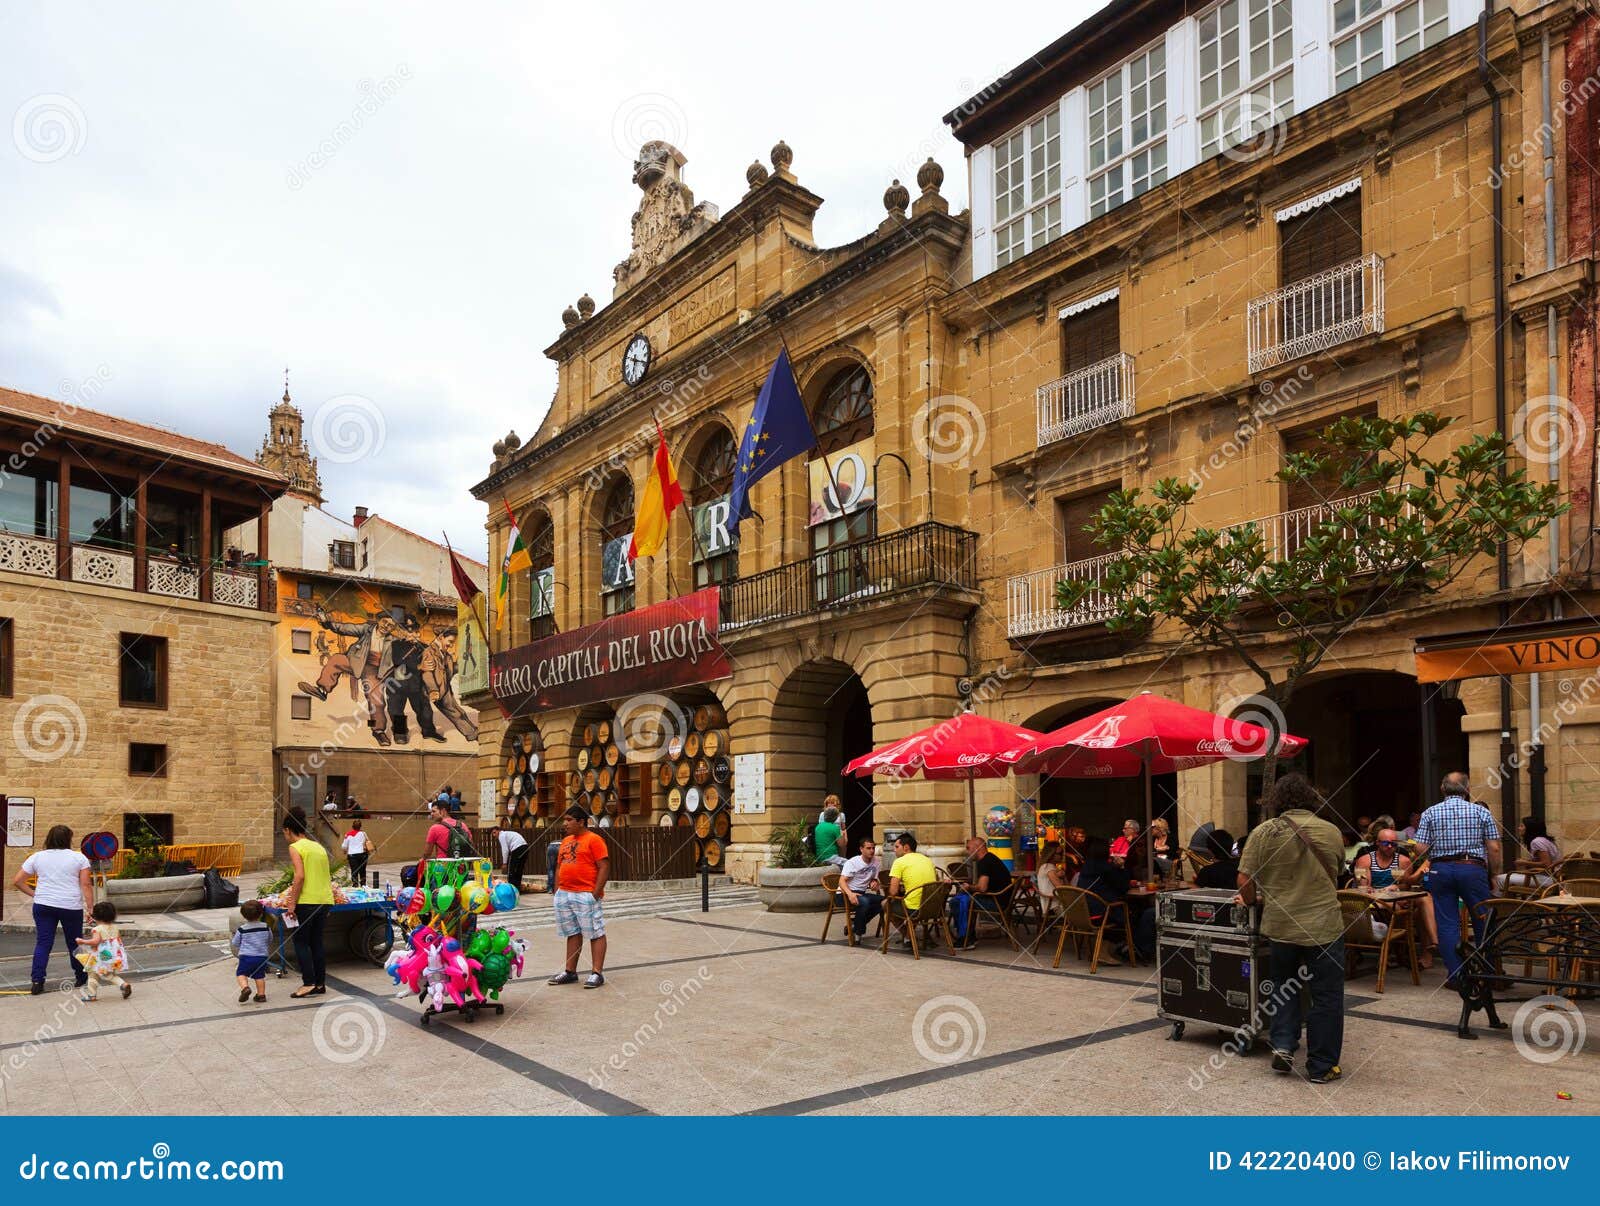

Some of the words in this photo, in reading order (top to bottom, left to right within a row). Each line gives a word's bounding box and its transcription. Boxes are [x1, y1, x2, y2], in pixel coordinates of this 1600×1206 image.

[613, 539, 634, 585] A
[708, 501, 732, 552] R
[828, 454, 867, 509] O
[493, 664, 538, 699] HARO,
[537, 645, 605, 688] CAPITAL
[608, 634, 646, 673] DEL
[649, 616, 714, 664] RIOJA
[1507, 636, 1600, 667] VINO
[1196, 738, 1233, 753] Coca-Cola
